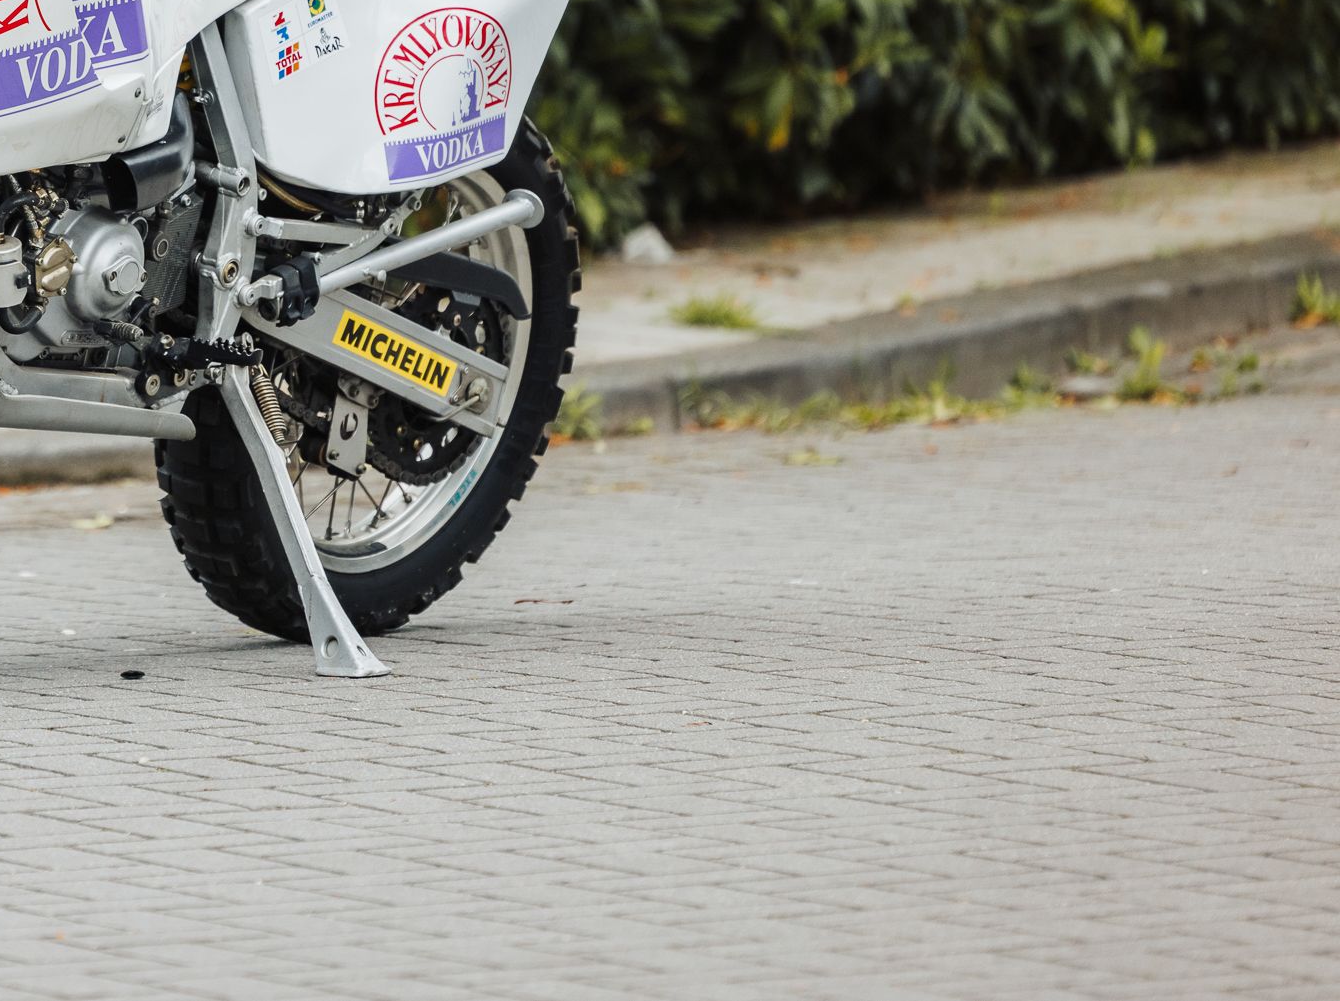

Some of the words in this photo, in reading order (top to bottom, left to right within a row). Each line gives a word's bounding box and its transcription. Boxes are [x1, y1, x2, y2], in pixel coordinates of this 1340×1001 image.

[275, 51, 303, 71] TOTAL
[314, 35, 346, 59] DAKAR
[383, 13, 509, 133] KREMLYOVSKAYA
[414, 128, 485, 172] VODKA
[340, 317, 450, 390] MICHELIN
